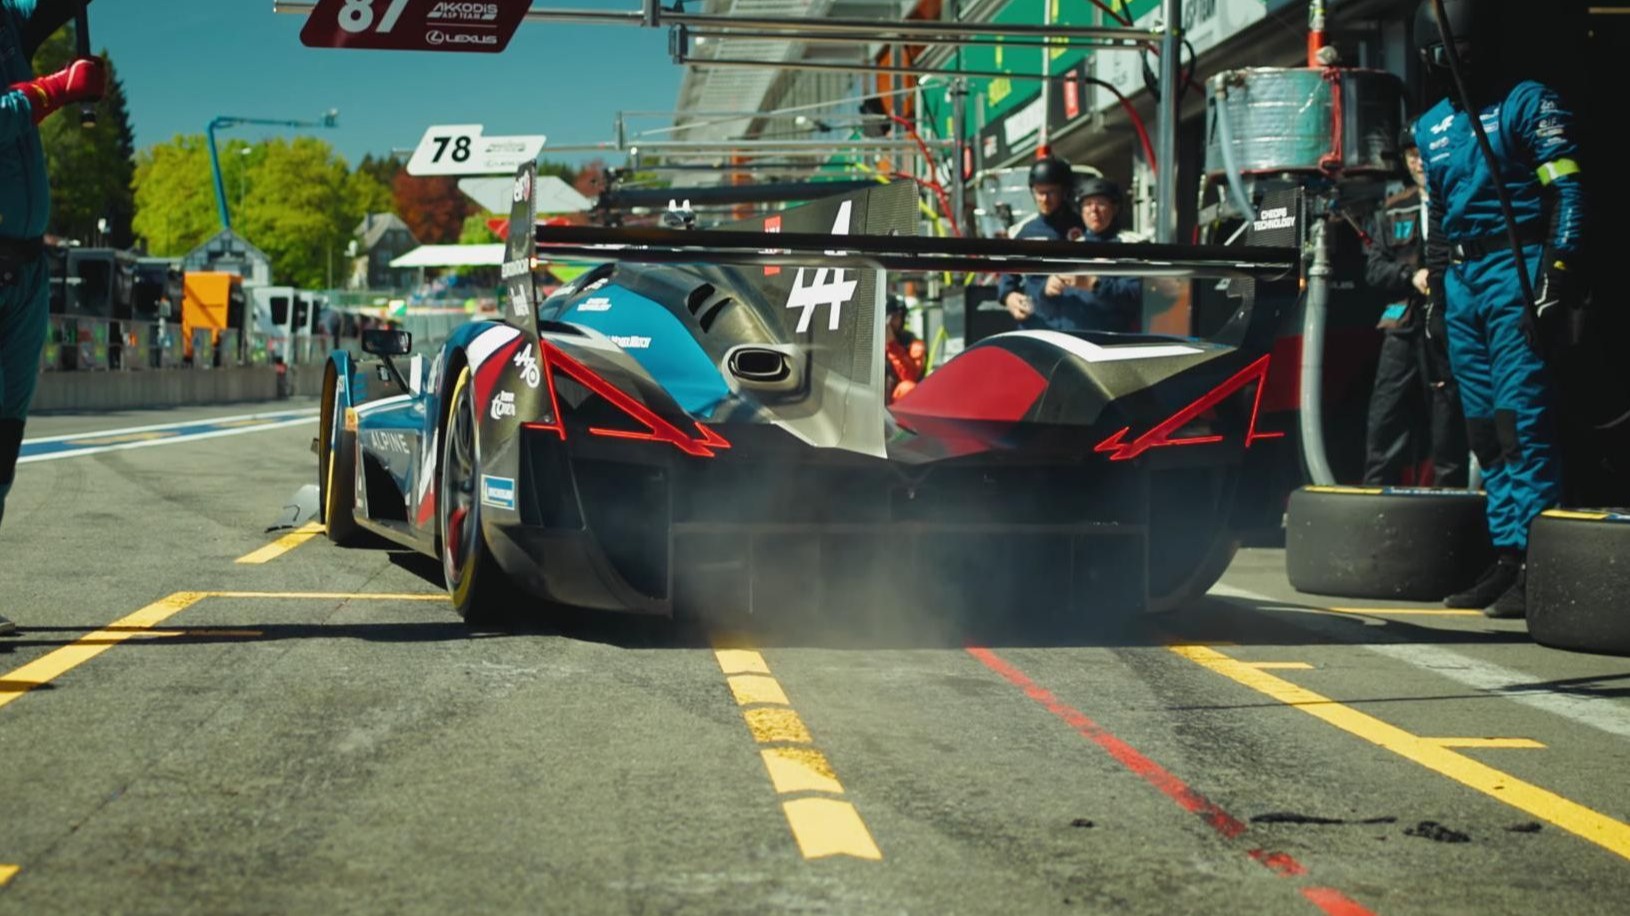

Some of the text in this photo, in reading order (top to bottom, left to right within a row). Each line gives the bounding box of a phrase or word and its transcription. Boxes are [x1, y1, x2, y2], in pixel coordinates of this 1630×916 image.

[445, 34, 498, 45] LEXUS
[432, 135, 471, 163] 78
[1253, 216, 1296, 231] TECHNOLOGY
[371, 430, 411, 455] ALPINE
